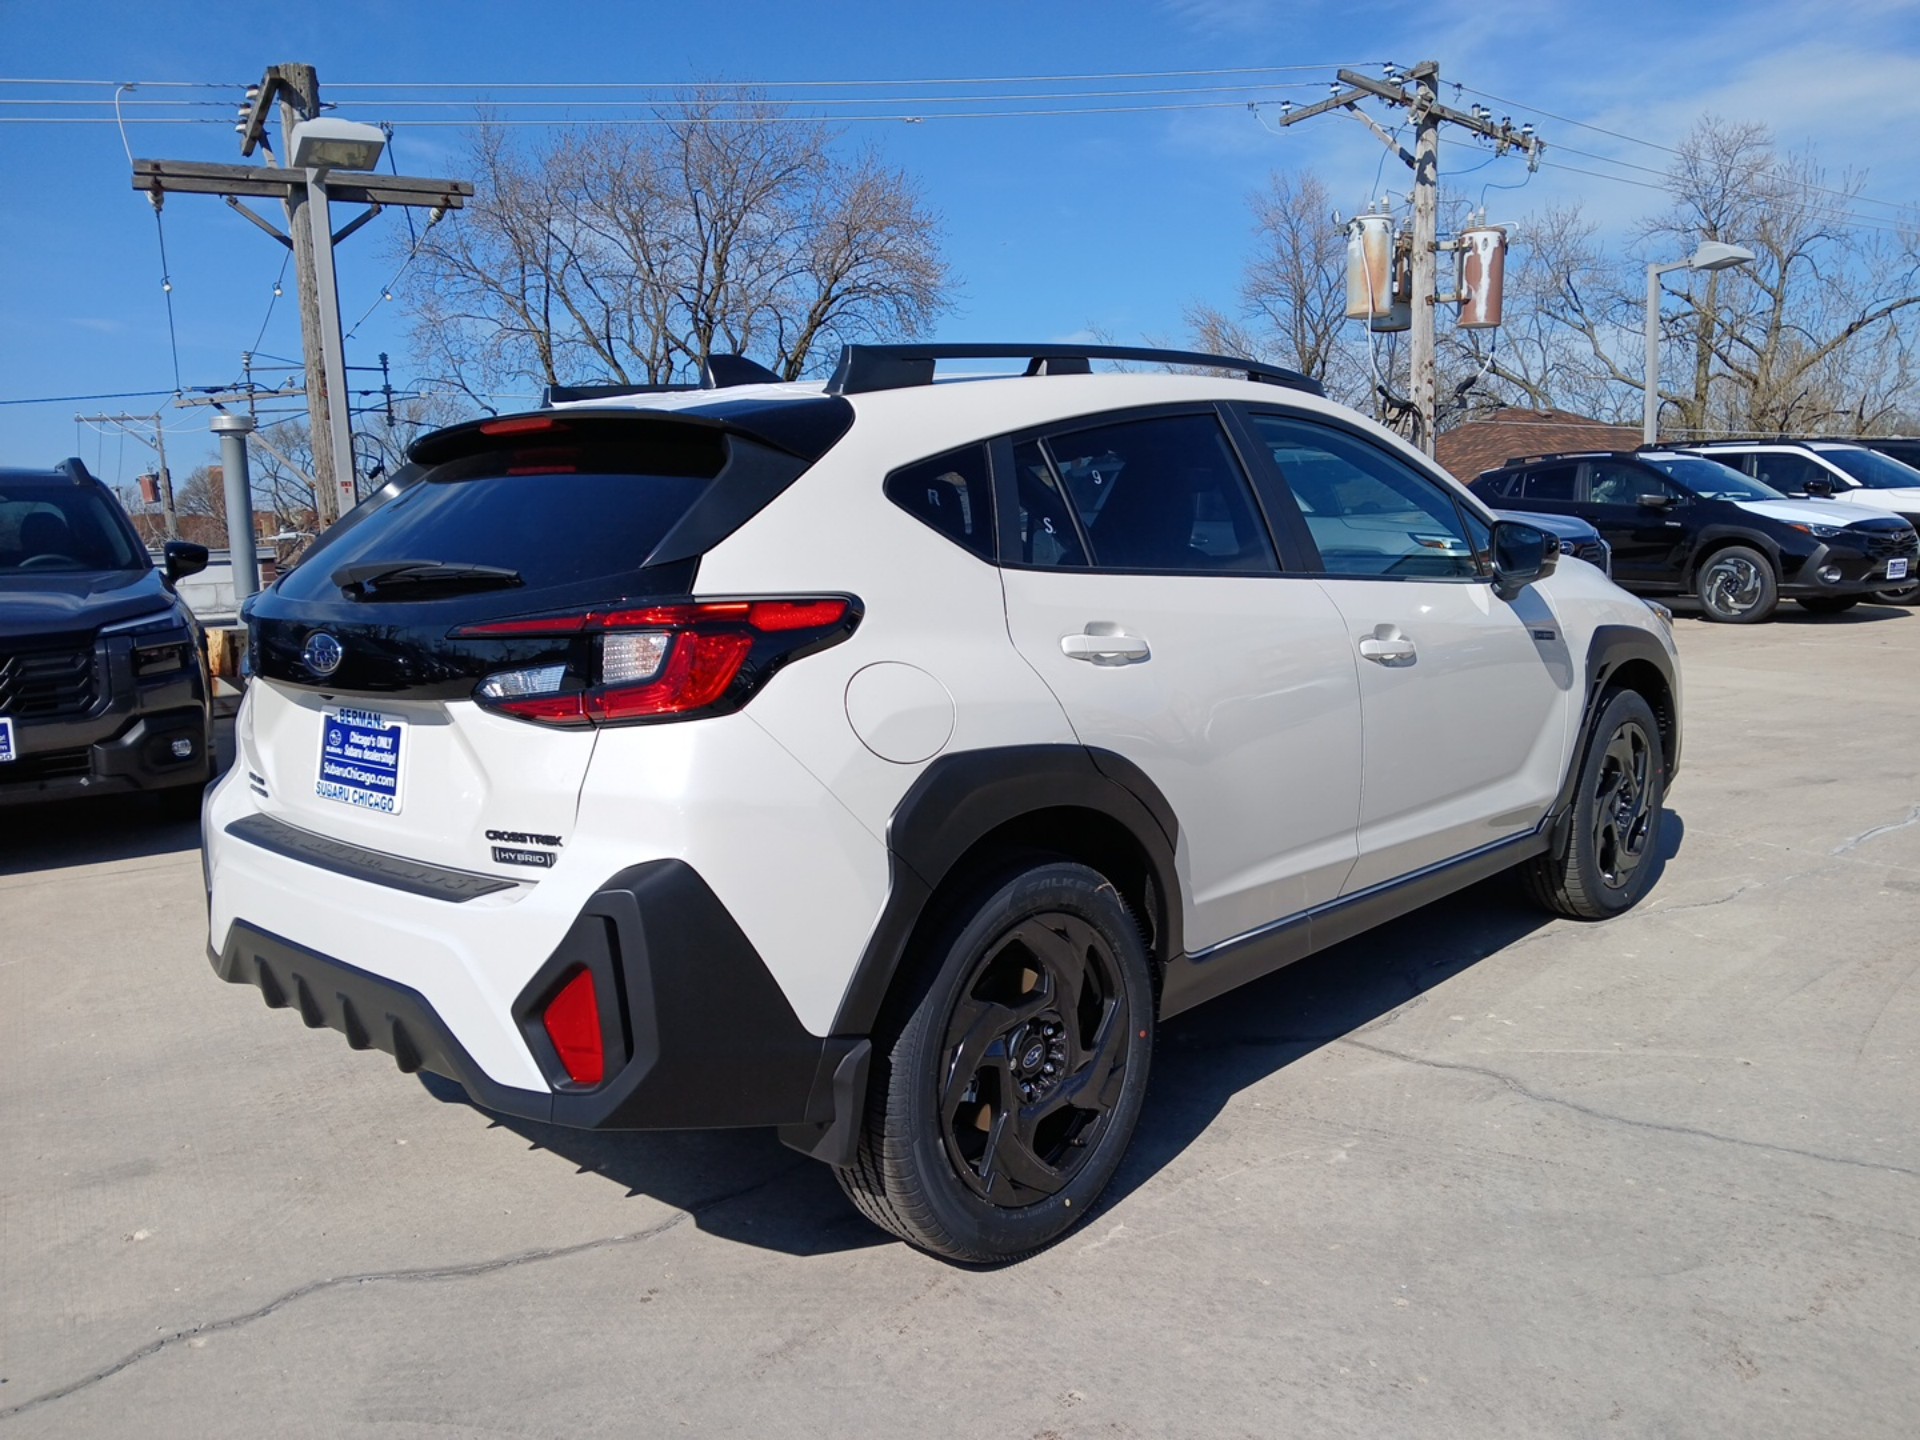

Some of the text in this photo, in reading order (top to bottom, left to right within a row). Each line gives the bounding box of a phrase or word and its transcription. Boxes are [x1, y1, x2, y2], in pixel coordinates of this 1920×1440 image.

[339, 708, 381, 728] BERMAN
[344, 744, 362, 758] Subaru
[376, 736, 393, 749] ONLY
[323, 762, 395, 788] SubaruChicago.com
[316, 781, 394, 812] SUBARU CHICAGO
[485, 830, 563, 847] CROSSTREK
[501, 852, 545, 863] HYBRID
